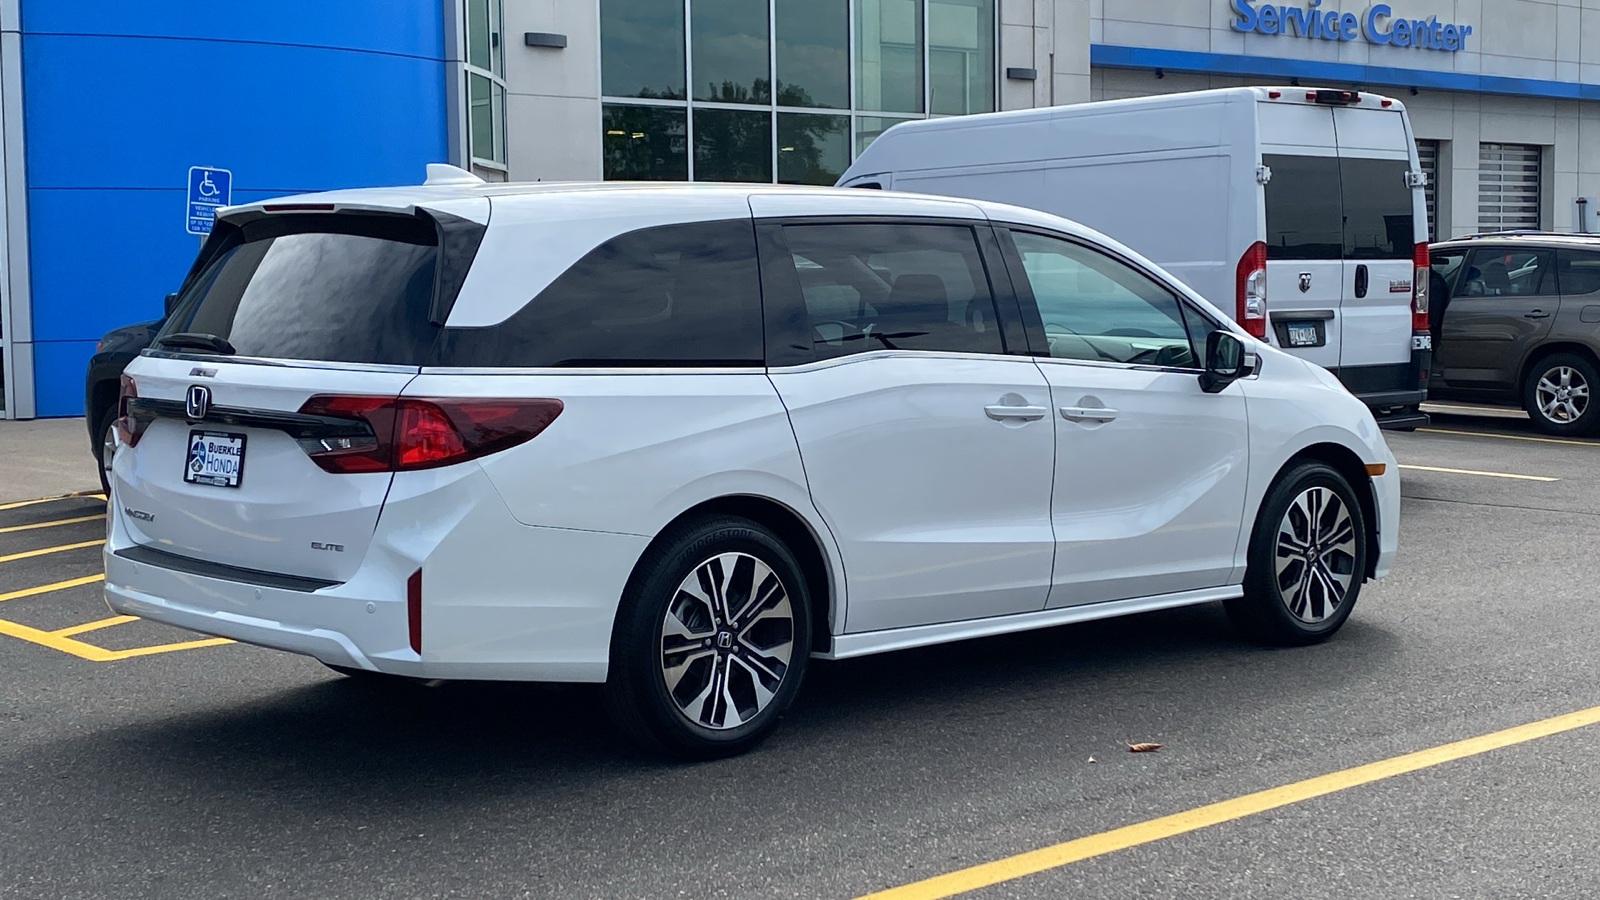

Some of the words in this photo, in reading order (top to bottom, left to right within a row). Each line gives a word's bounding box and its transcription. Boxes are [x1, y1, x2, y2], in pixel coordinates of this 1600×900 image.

[1231, 0, 1357, 41] Service
[1363, 4, 1472, 51] Center
[208, 441, 241, 456] BUERKLE
[205, 454, 238, 474] HONDA
[311, 541, 344, 552] ELITE
